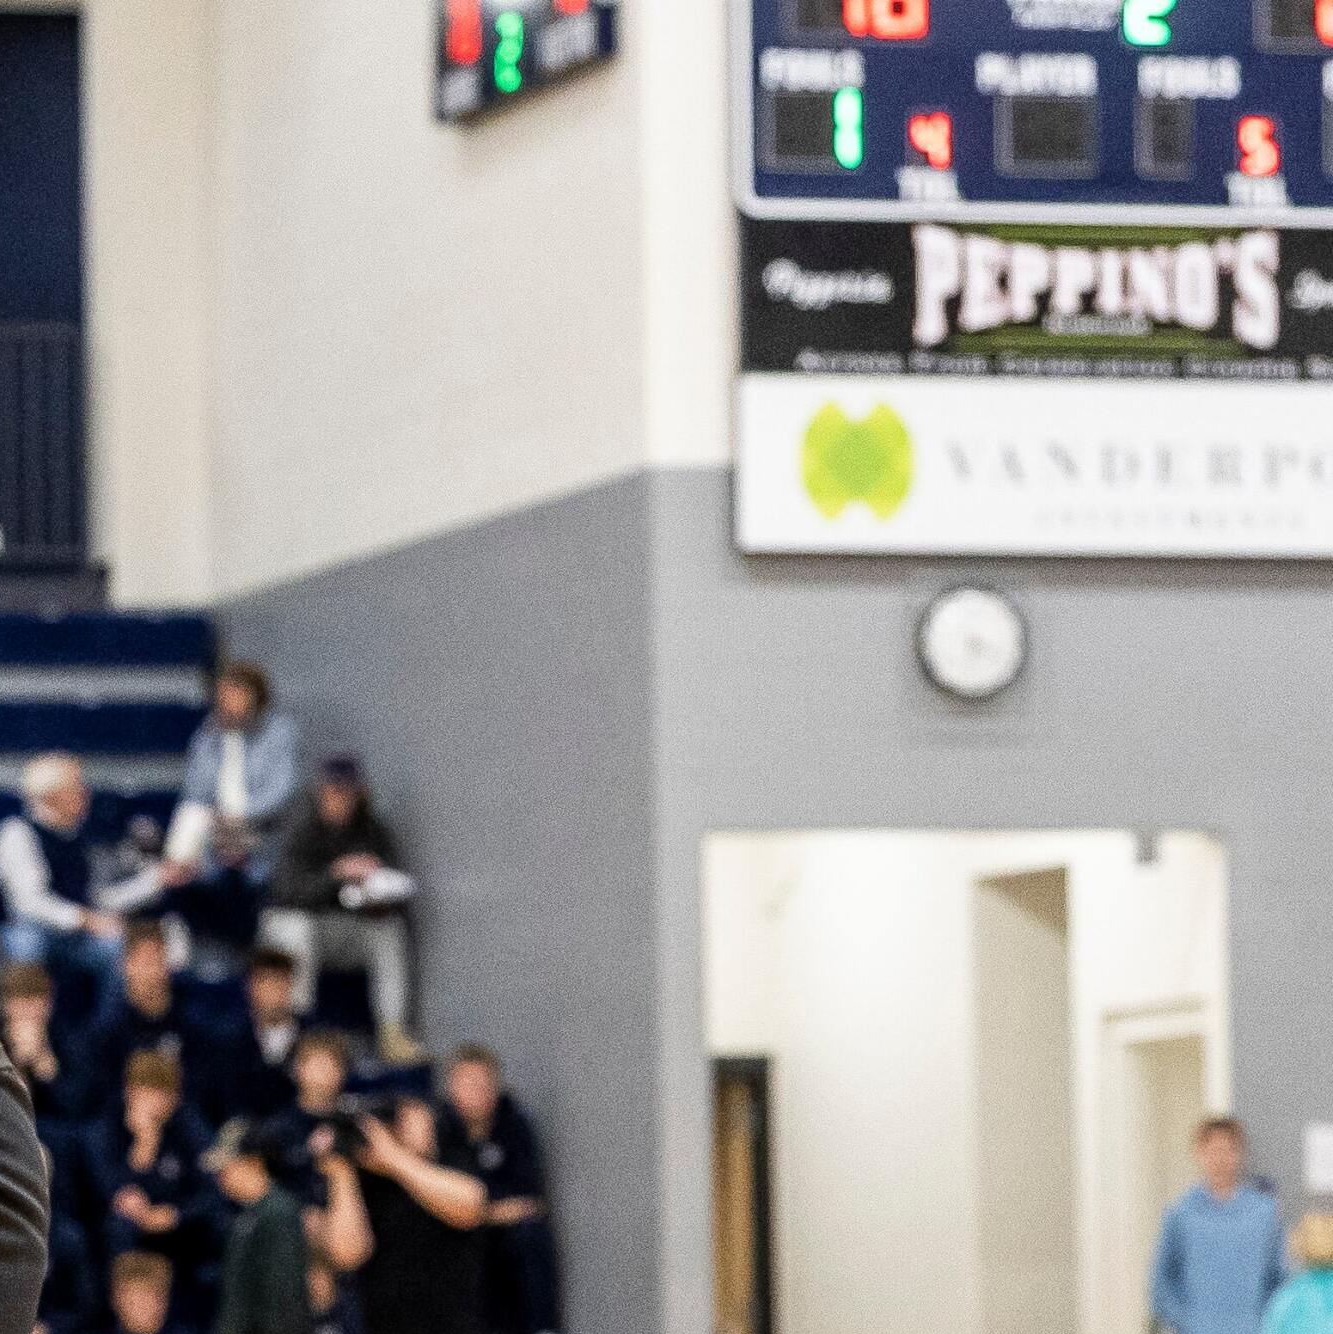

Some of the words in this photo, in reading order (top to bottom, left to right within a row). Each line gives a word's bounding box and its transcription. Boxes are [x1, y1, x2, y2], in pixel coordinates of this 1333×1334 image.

[907, 111, 953, 170] 4
[1237, 115, 1281, 177] 5
[912, 225, 1281, 349] PEPPINO'S
